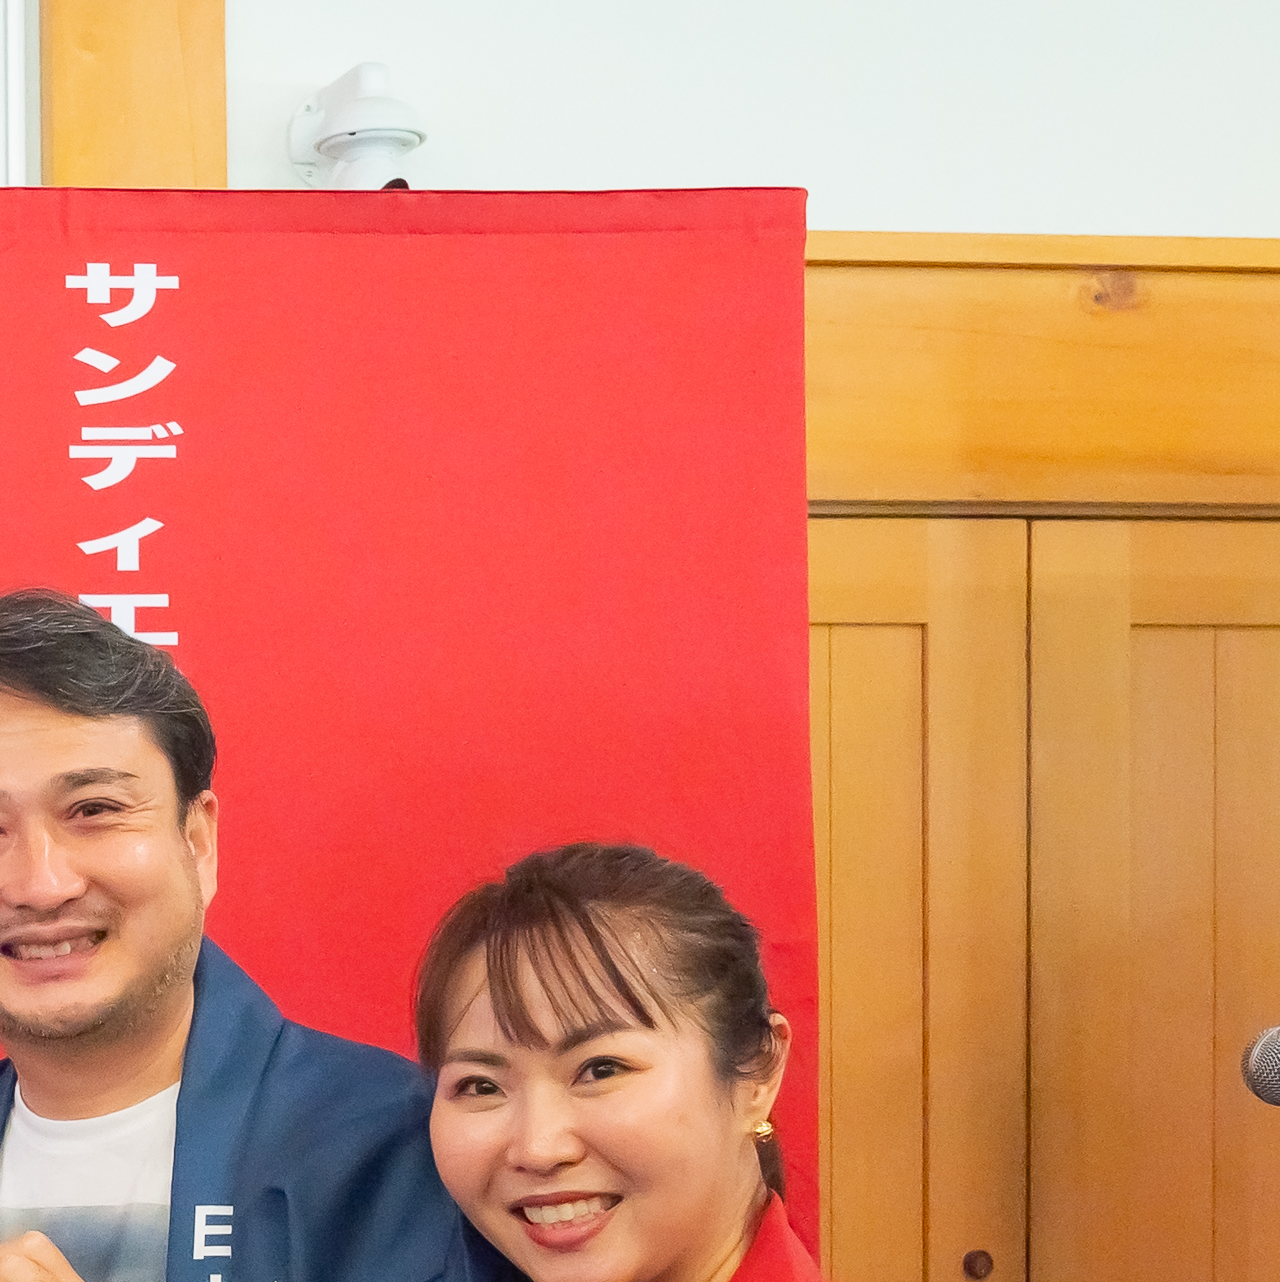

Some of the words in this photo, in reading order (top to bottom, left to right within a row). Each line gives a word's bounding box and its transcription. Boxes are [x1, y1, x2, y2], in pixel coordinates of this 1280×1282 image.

[65, 262, 184, 646] サンディエ
